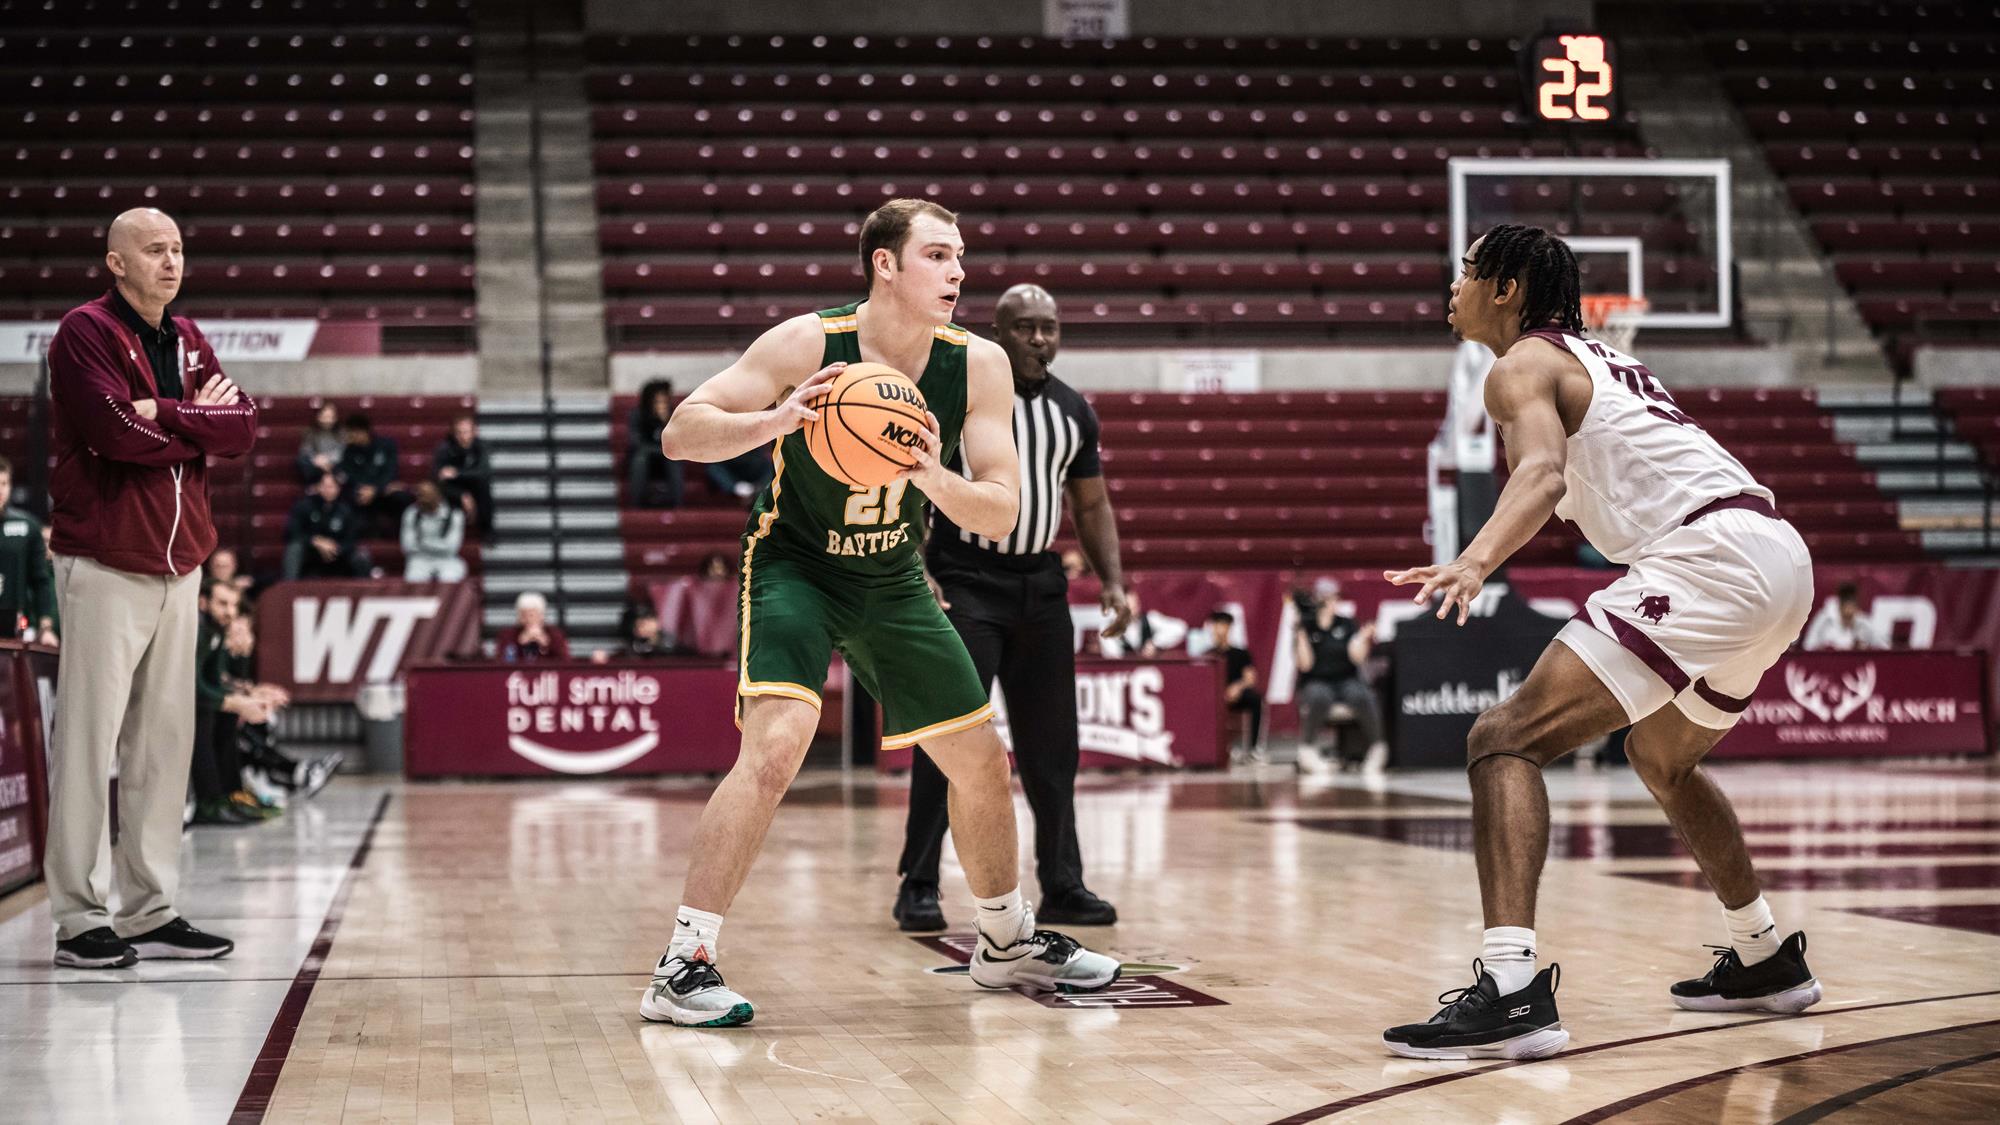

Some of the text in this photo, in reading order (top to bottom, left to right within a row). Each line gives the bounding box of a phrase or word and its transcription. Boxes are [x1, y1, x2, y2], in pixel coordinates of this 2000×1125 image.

[1540, 57, 1612, 120] 22
[875, 382, 928, 413] Wilso
[825, 522, 911, 558] BAPTIST
[293, 597, 440, 684] WT
[505, 670, 661, 706] full smile
[1401, 669, 1524, 715] suddenli
[507, 706, 661, 733] DENTAL
[1866, 695, 1957, 725] RANCH
